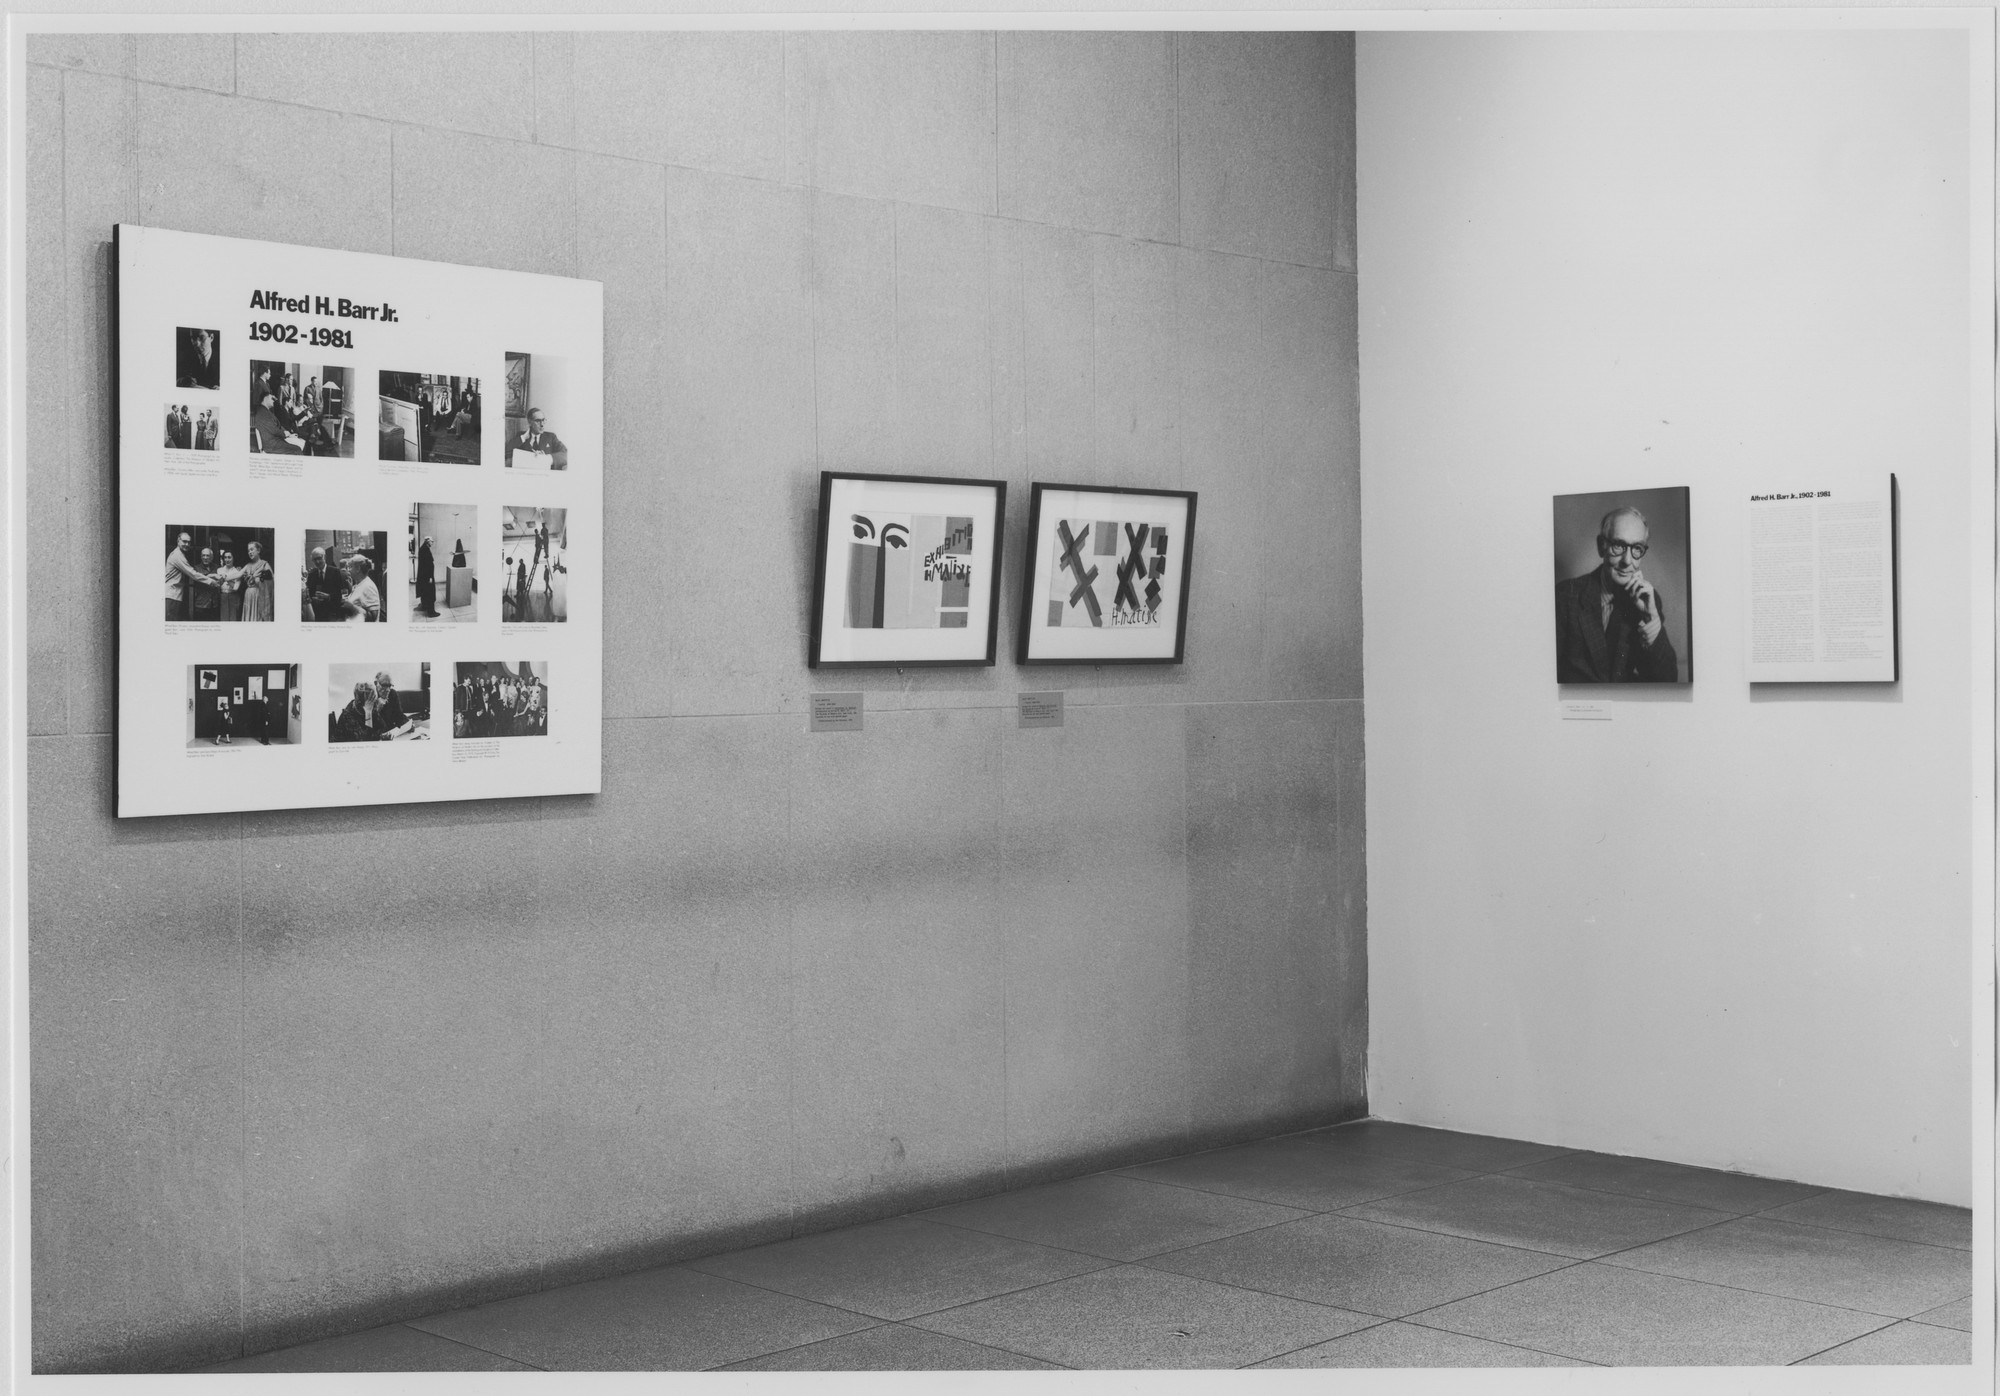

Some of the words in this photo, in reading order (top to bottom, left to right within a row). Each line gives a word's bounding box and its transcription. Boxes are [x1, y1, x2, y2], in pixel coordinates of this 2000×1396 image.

[249, 289, 310, 314] Alfred
[315, 295, 335, 316] H.
[338, 298, 379, 320] Barr
[380, 303, 399, 323] Jr.
